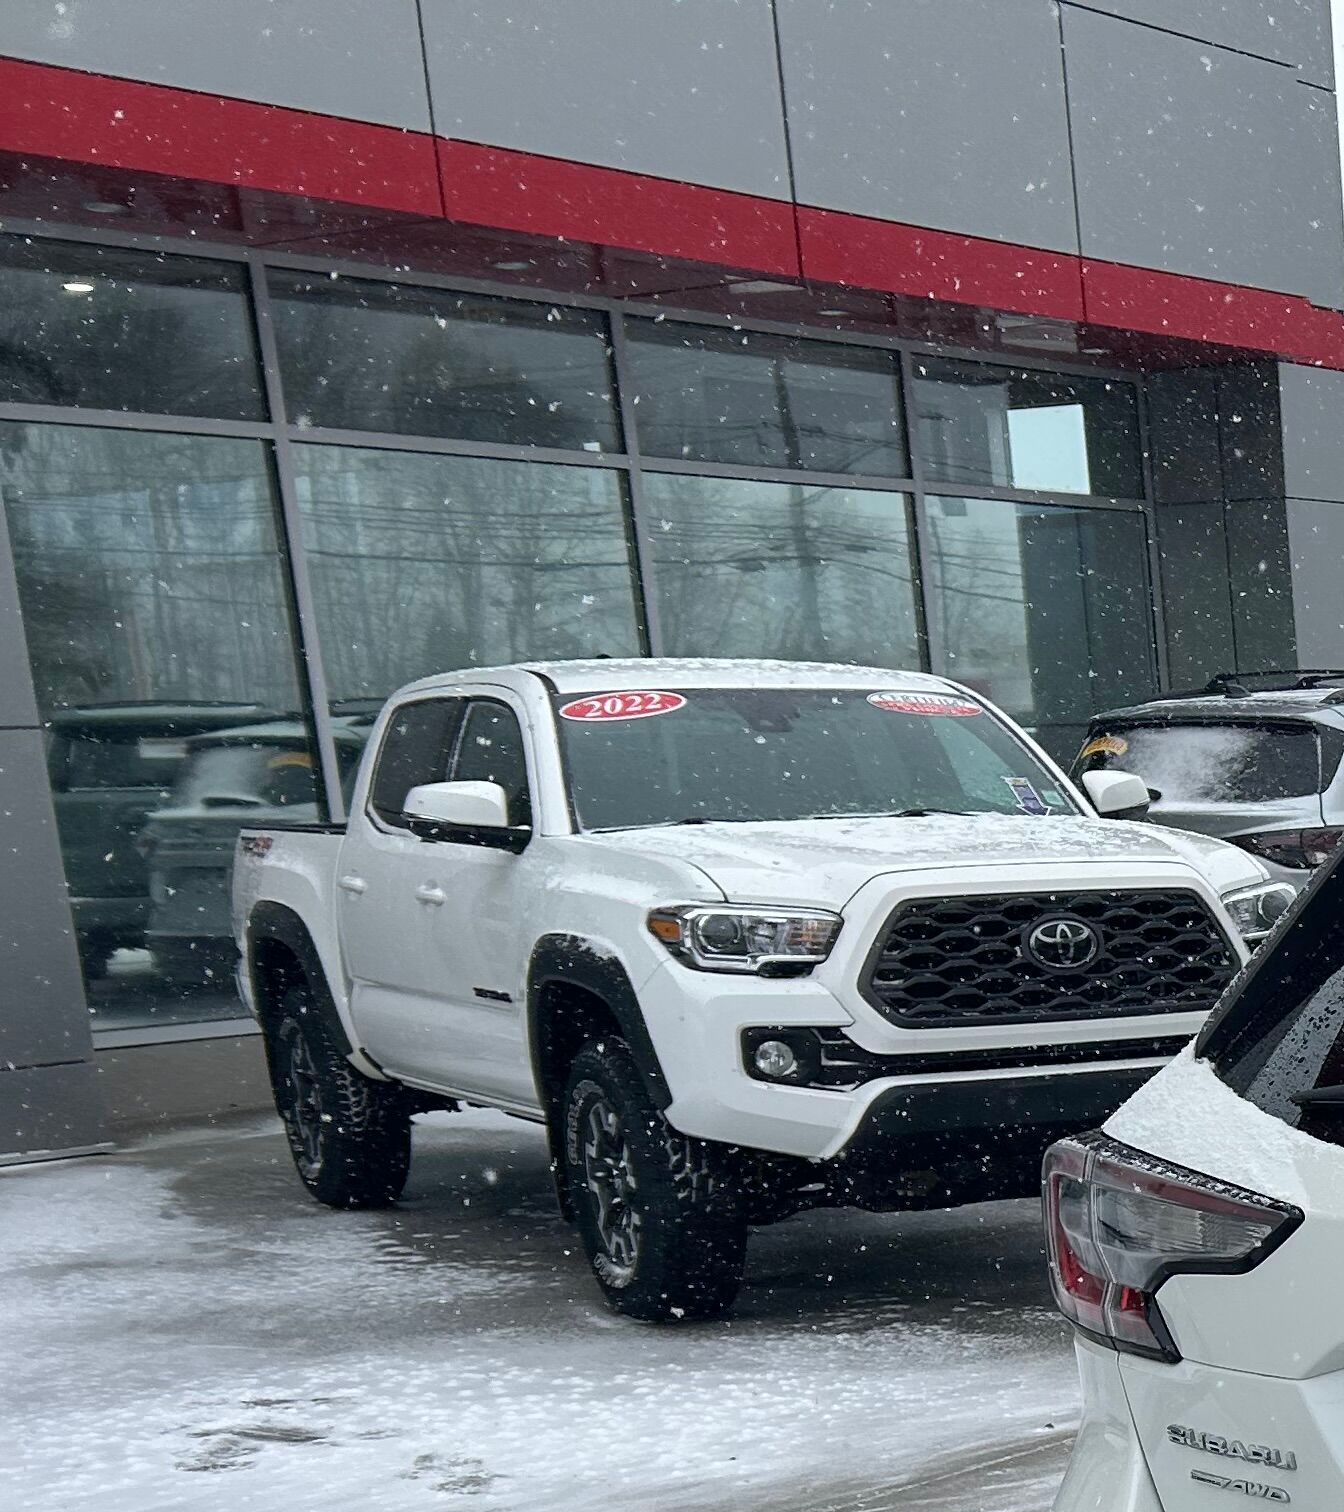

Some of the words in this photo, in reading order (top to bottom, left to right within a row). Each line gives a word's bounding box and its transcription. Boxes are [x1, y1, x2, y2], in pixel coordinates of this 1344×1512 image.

[584, 693, 662, 717] 2022
[1166, 1424, 1298, 1471] SUBARU
[1226, 1478, 1291, 1503] AWD
